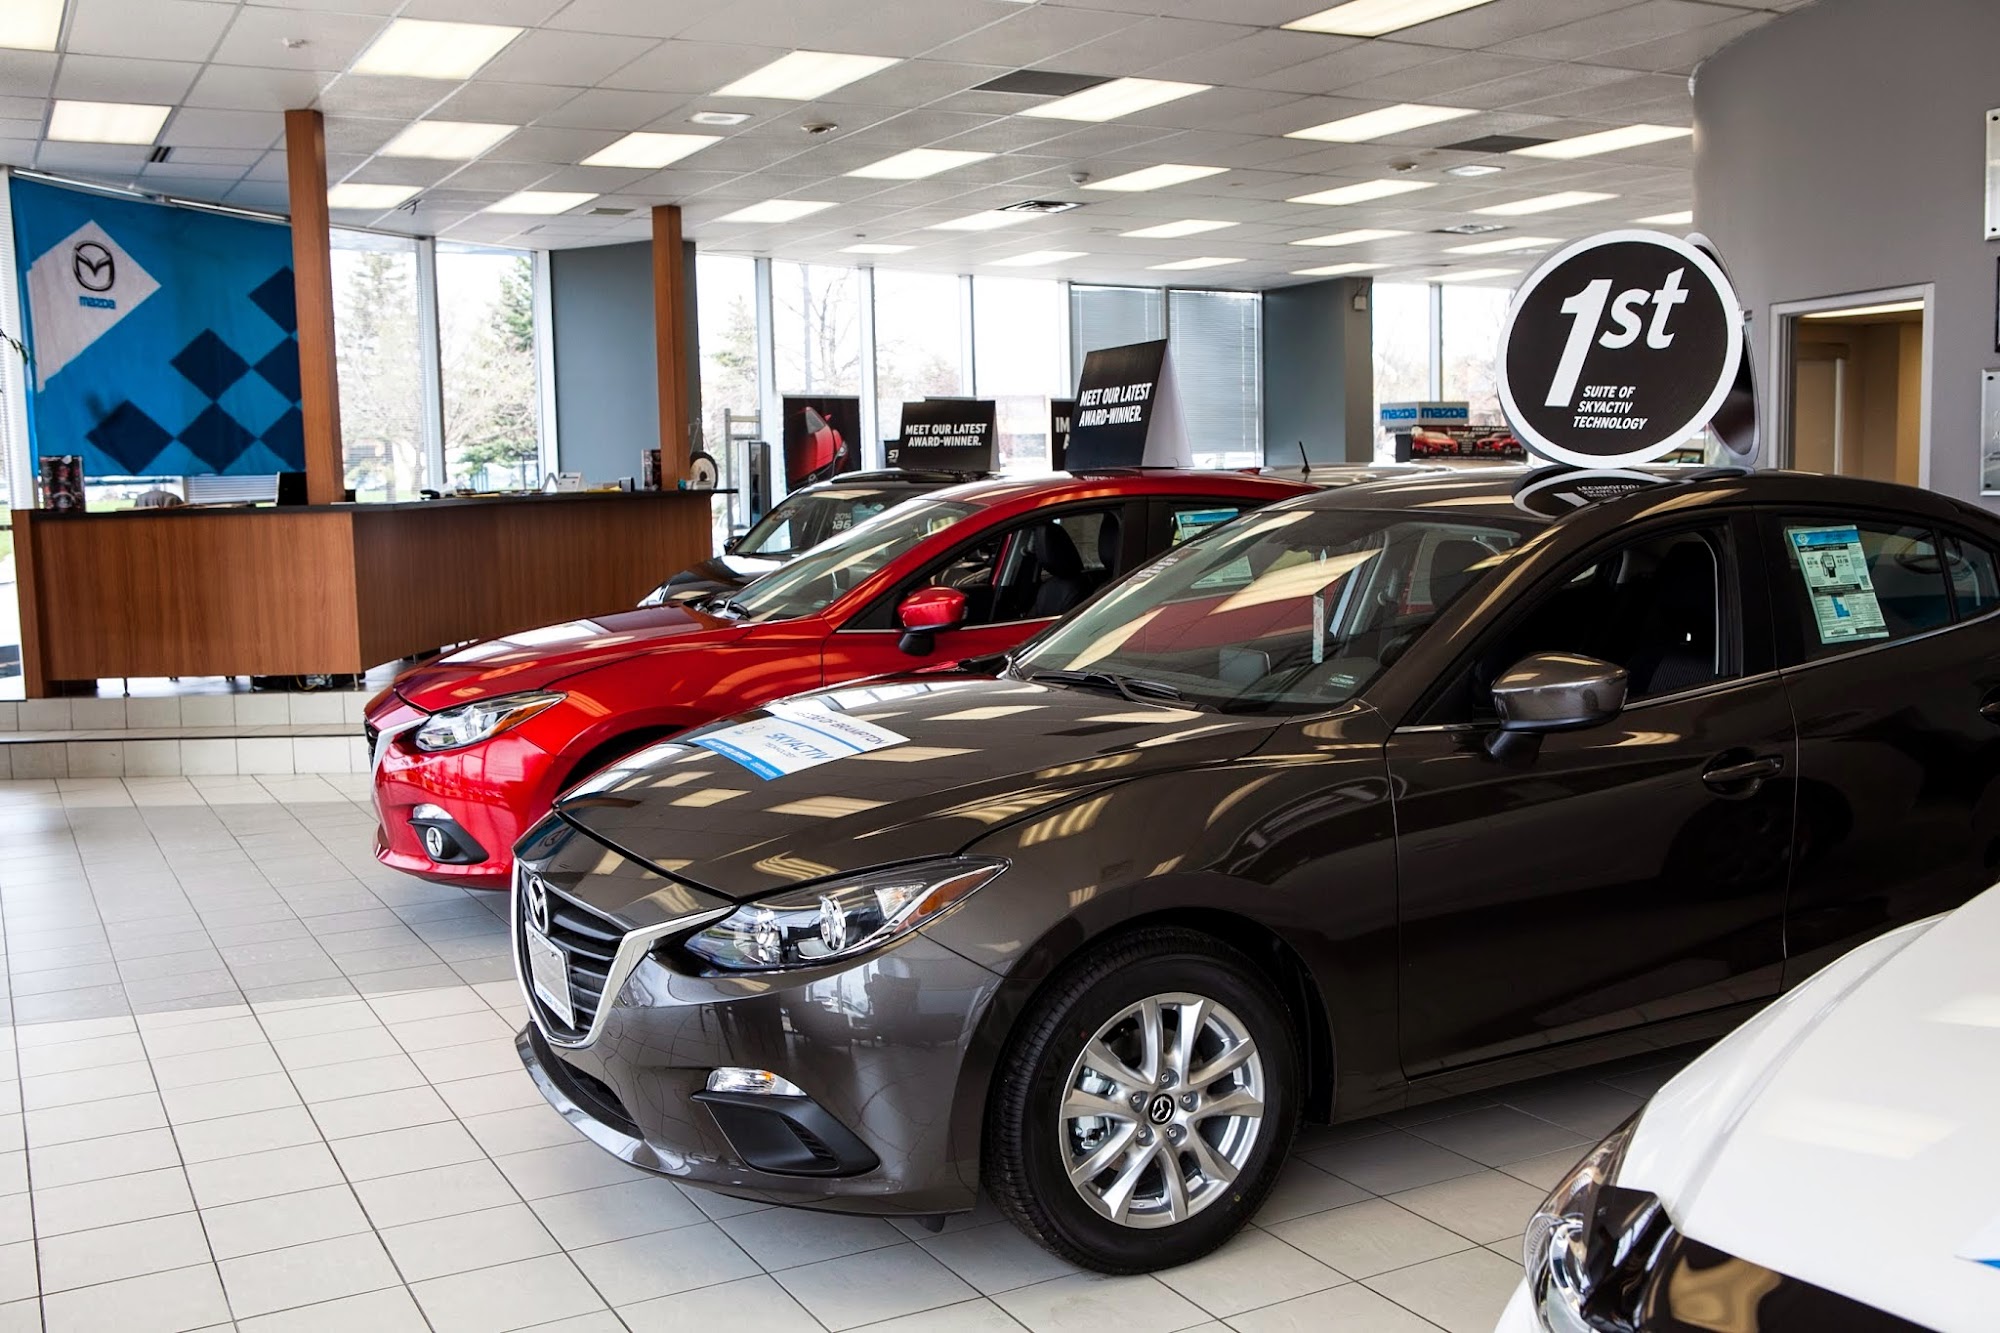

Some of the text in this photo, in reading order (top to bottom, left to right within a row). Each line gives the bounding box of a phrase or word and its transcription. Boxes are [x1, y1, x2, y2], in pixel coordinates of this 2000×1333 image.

[79, 296, 115, 309] mazda
[1544, 267, 1689, 407] 1st
[1079, 383, 1152, 407] MEET OUR LATEST
[1583, 386, 1636, 398] SUITE OF
[1421, 407, 1468, 419] mazda
[1577, 401, 1633, 413] SKYACTIV
[1078, 406, 1142, 428] AWARD-WINNER.
[1381, 408, 1417, 420] mazda
[905, 423, 987, 435] MEET OUR LATEST
[1573, 416, 1648, 430] TECHNOLOGY
[908, 436, 982, 448] AWARD-WINNER.
